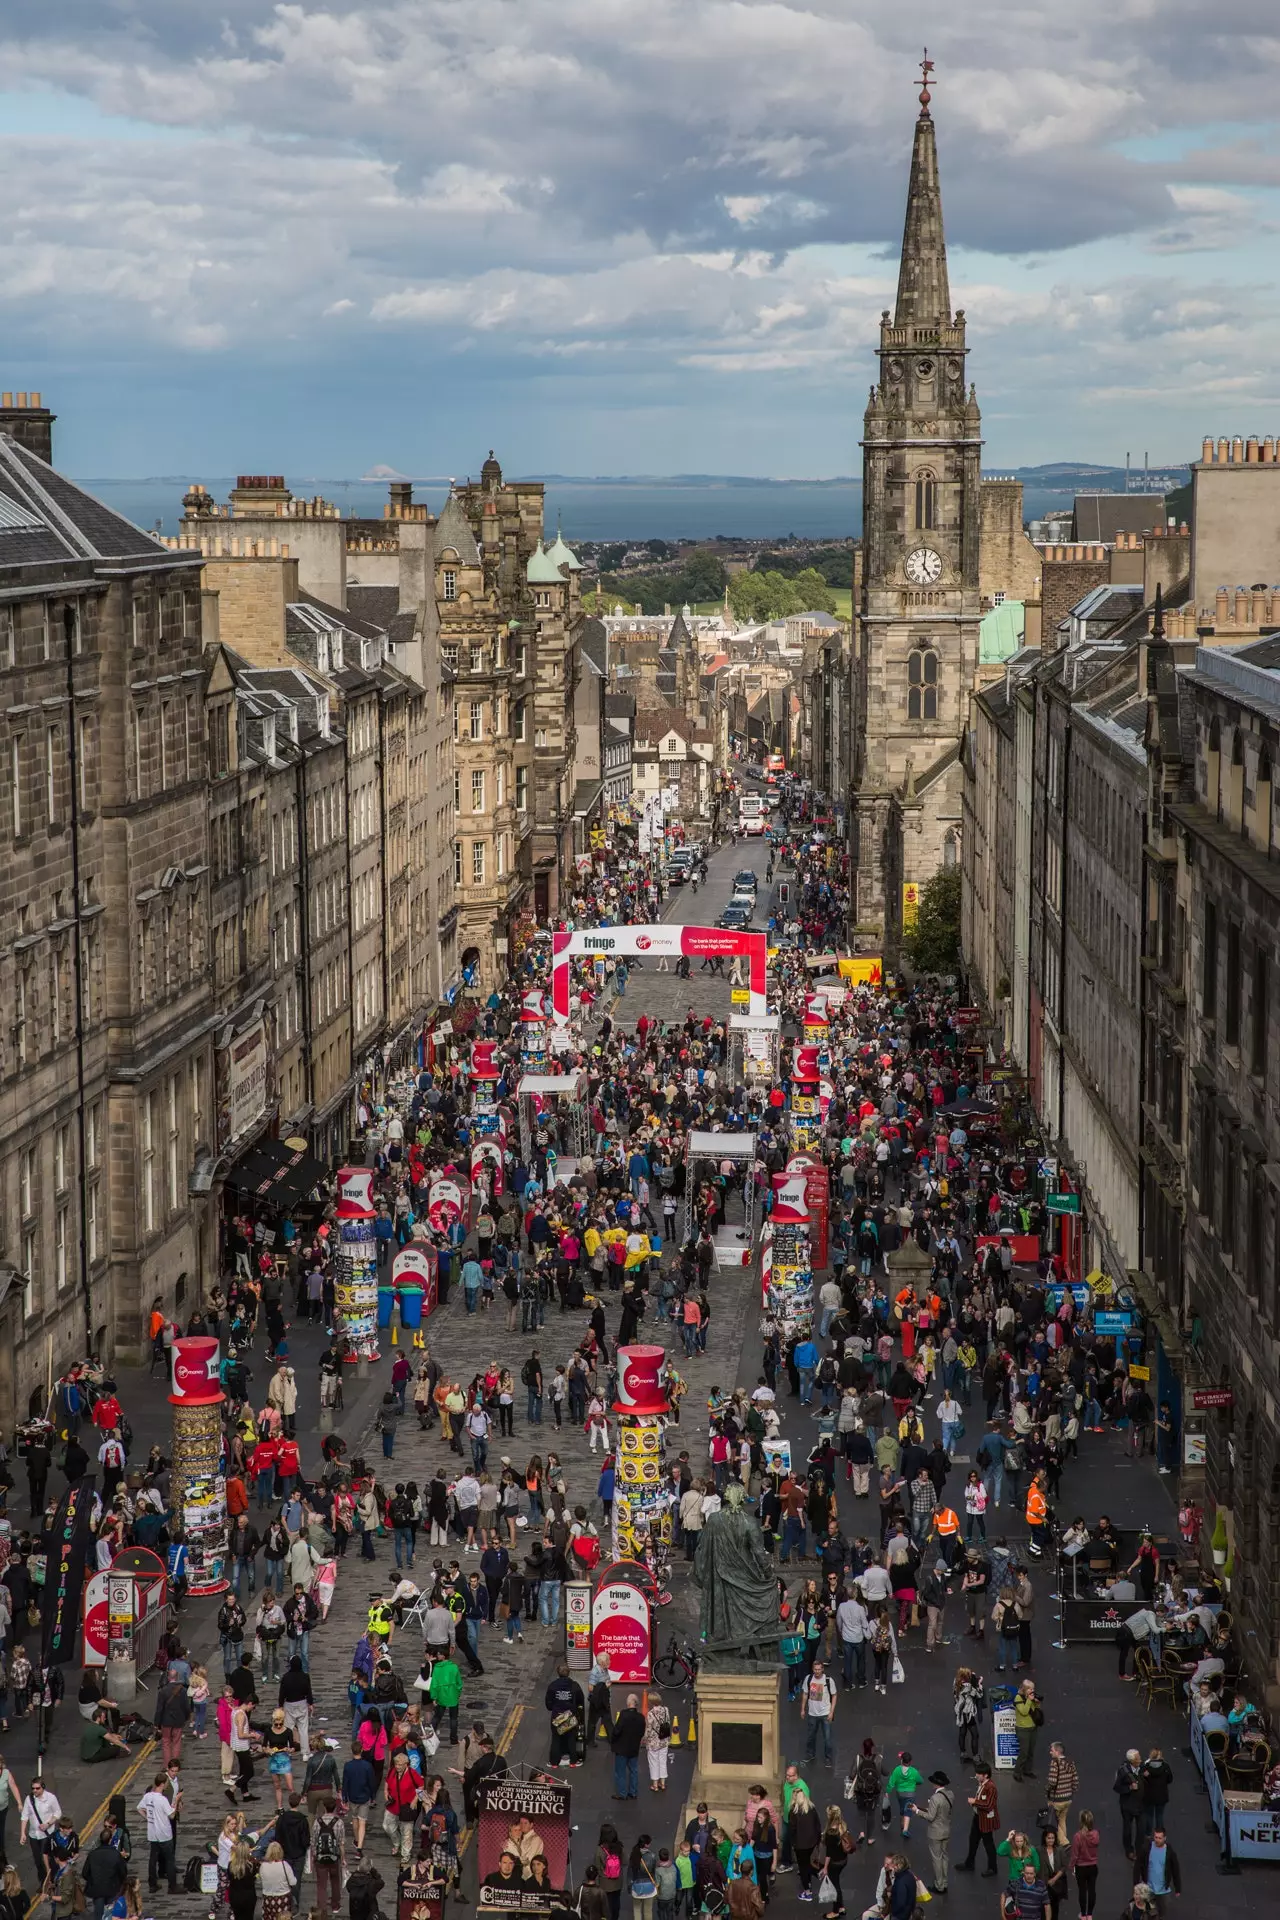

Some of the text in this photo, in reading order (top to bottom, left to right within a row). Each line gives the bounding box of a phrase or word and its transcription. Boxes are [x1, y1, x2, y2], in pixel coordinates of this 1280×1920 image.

[583, 936, 616, 950] fringe
[652, 938, 673, 946] money
[343, 1189, 363, 1198] fringe
[779, 1194, 800, 1203] fringe
[63, 1488, 80, 1540] Face
[52, 1543, 72, 1649] Painting
[609, 1590, 631, 1600] fringe
[1090, 1620, 1124, 1629] Heinek
[487, 1790, 565, 1803] MUCH ADO ABOUT
[486, 1797, 565, 1815] NOTHING
[403, 1891, 440, 1899] NOTHING
